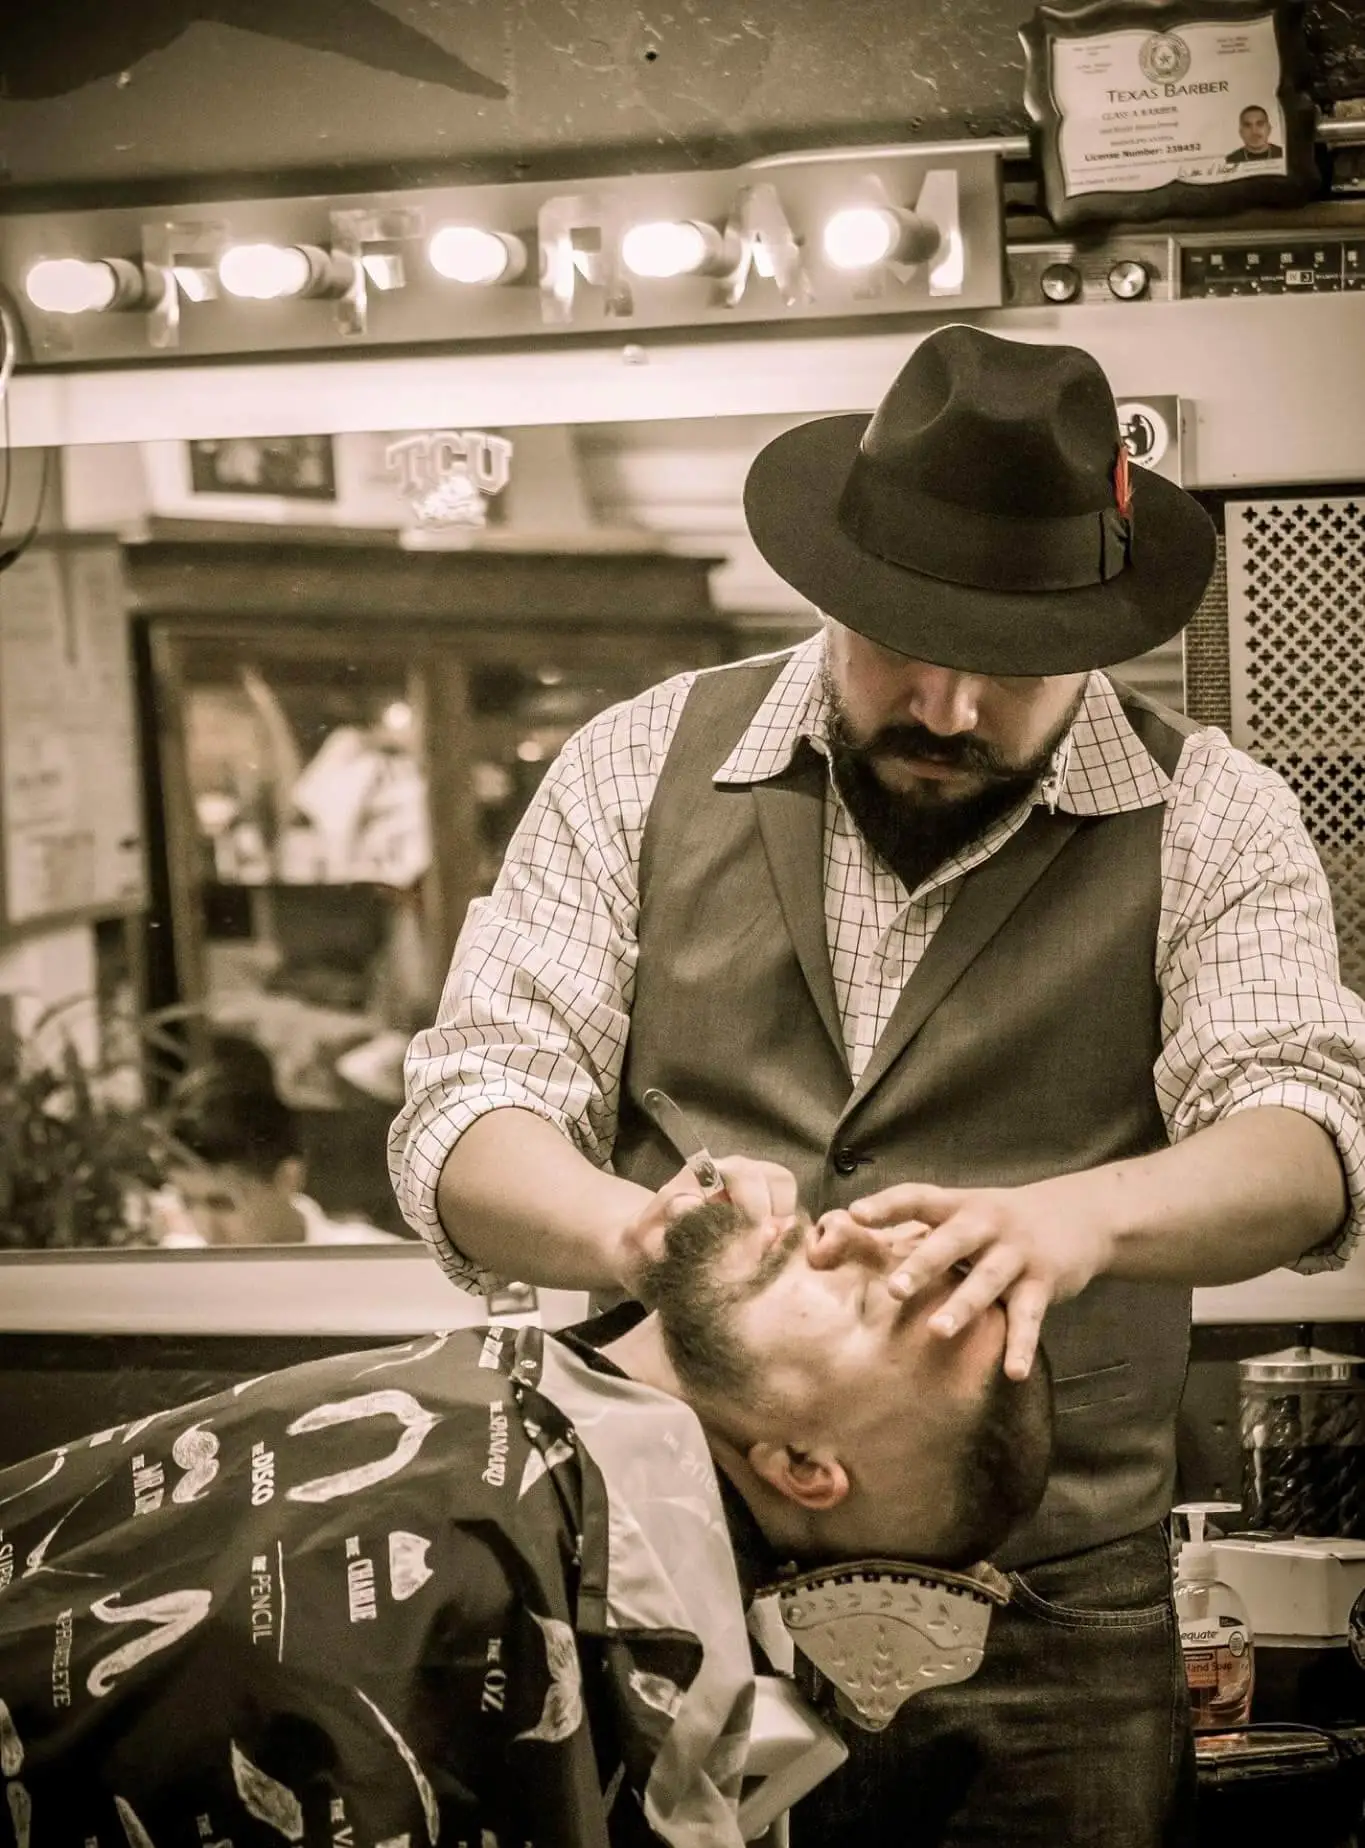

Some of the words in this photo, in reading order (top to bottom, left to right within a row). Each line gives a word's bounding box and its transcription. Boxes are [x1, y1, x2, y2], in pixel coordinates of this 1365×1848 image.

[1107, 87, 1159, 103] TEXAS
[1164, 80, 1229, 98] BARBER
[386, 431, 513, 497] TCU
[251, 1451, 274, 1505] DISCO
[250, 1574, 273, 1645] PENCIL
[1180, 1630, 1218, 1640] equate
[480, 1668, 508, 1713] OZ
